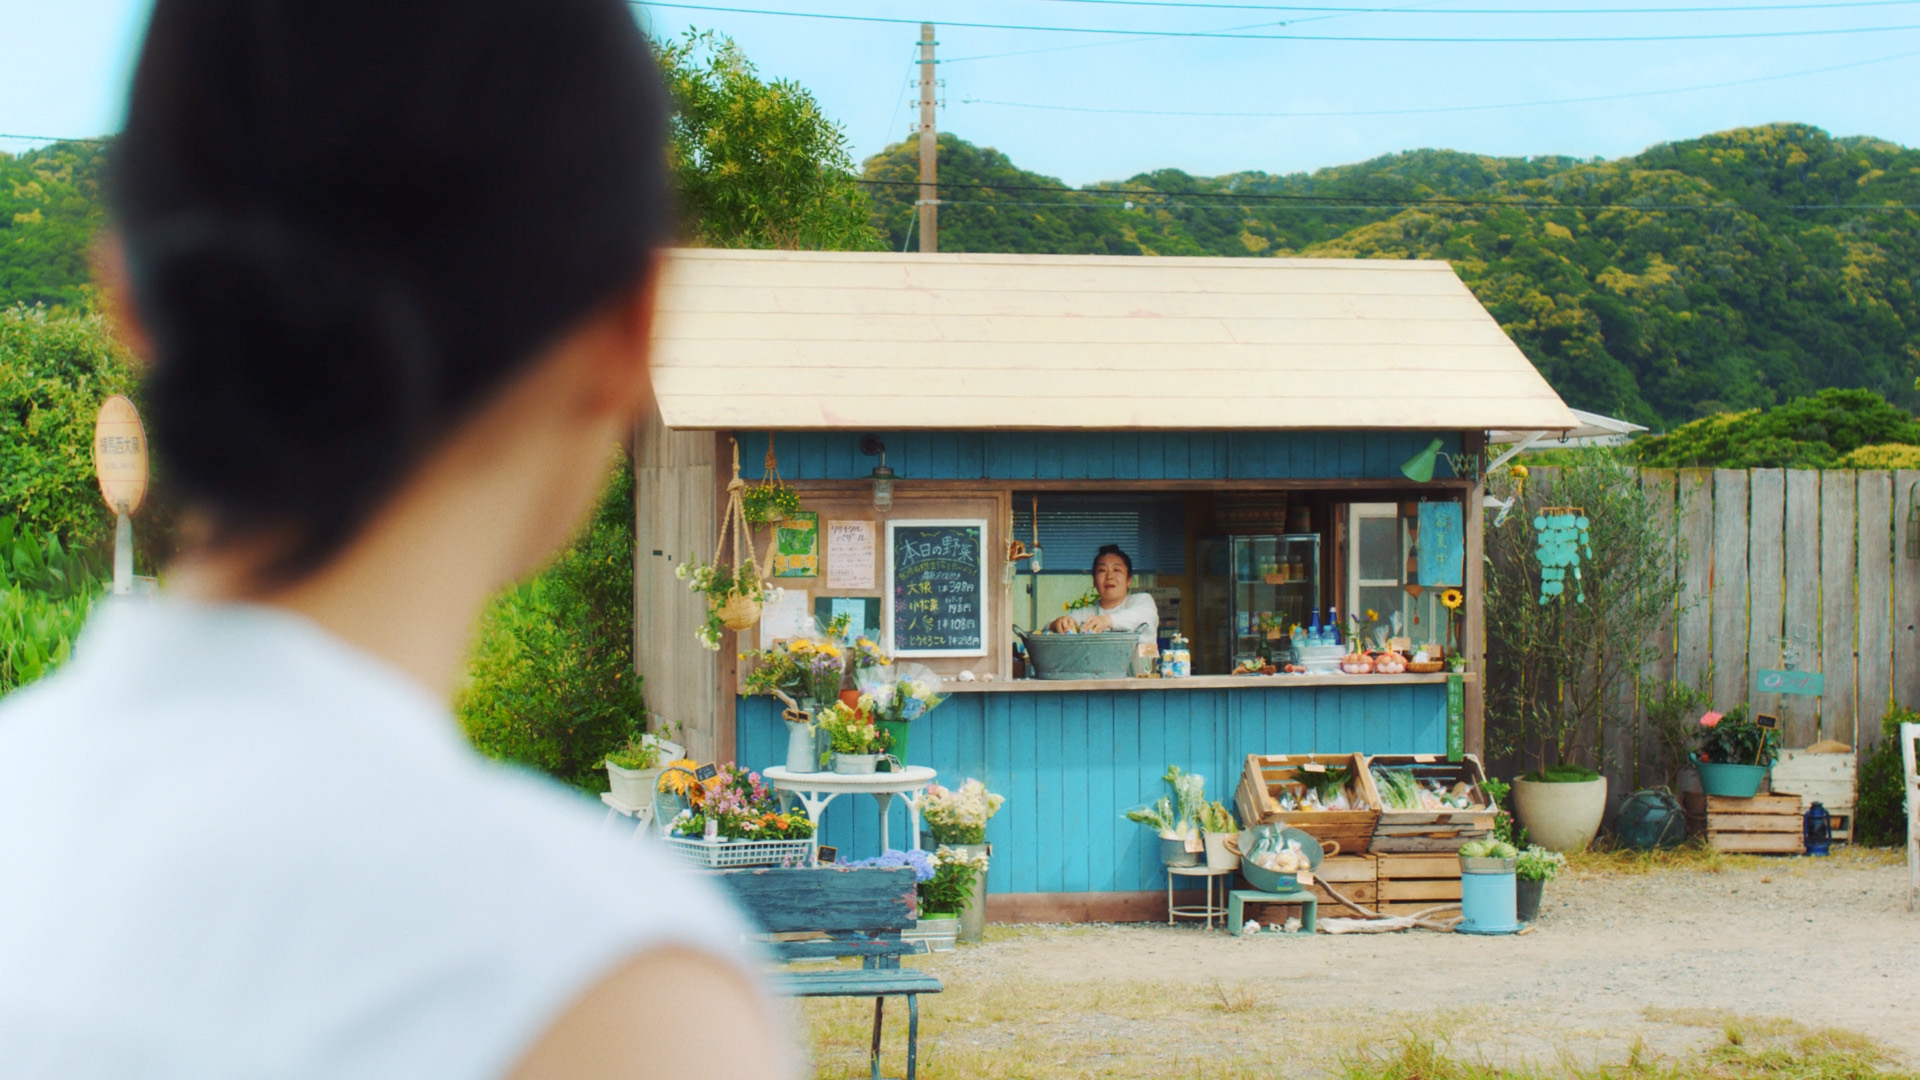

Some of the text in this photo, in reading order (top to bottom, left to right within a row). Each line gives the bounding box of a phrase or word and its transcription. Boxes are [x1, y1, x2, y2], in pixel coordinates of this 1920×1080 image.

[899, 536, 974, 566] 本日の野菜
[907, 581, 975, 596] 大根 1本398円
[909, 598, 972, 614] 小松菜 198円
[937, 618, 976, 631] 1本108円
[909, 635, 946, 647] とうもろこし
